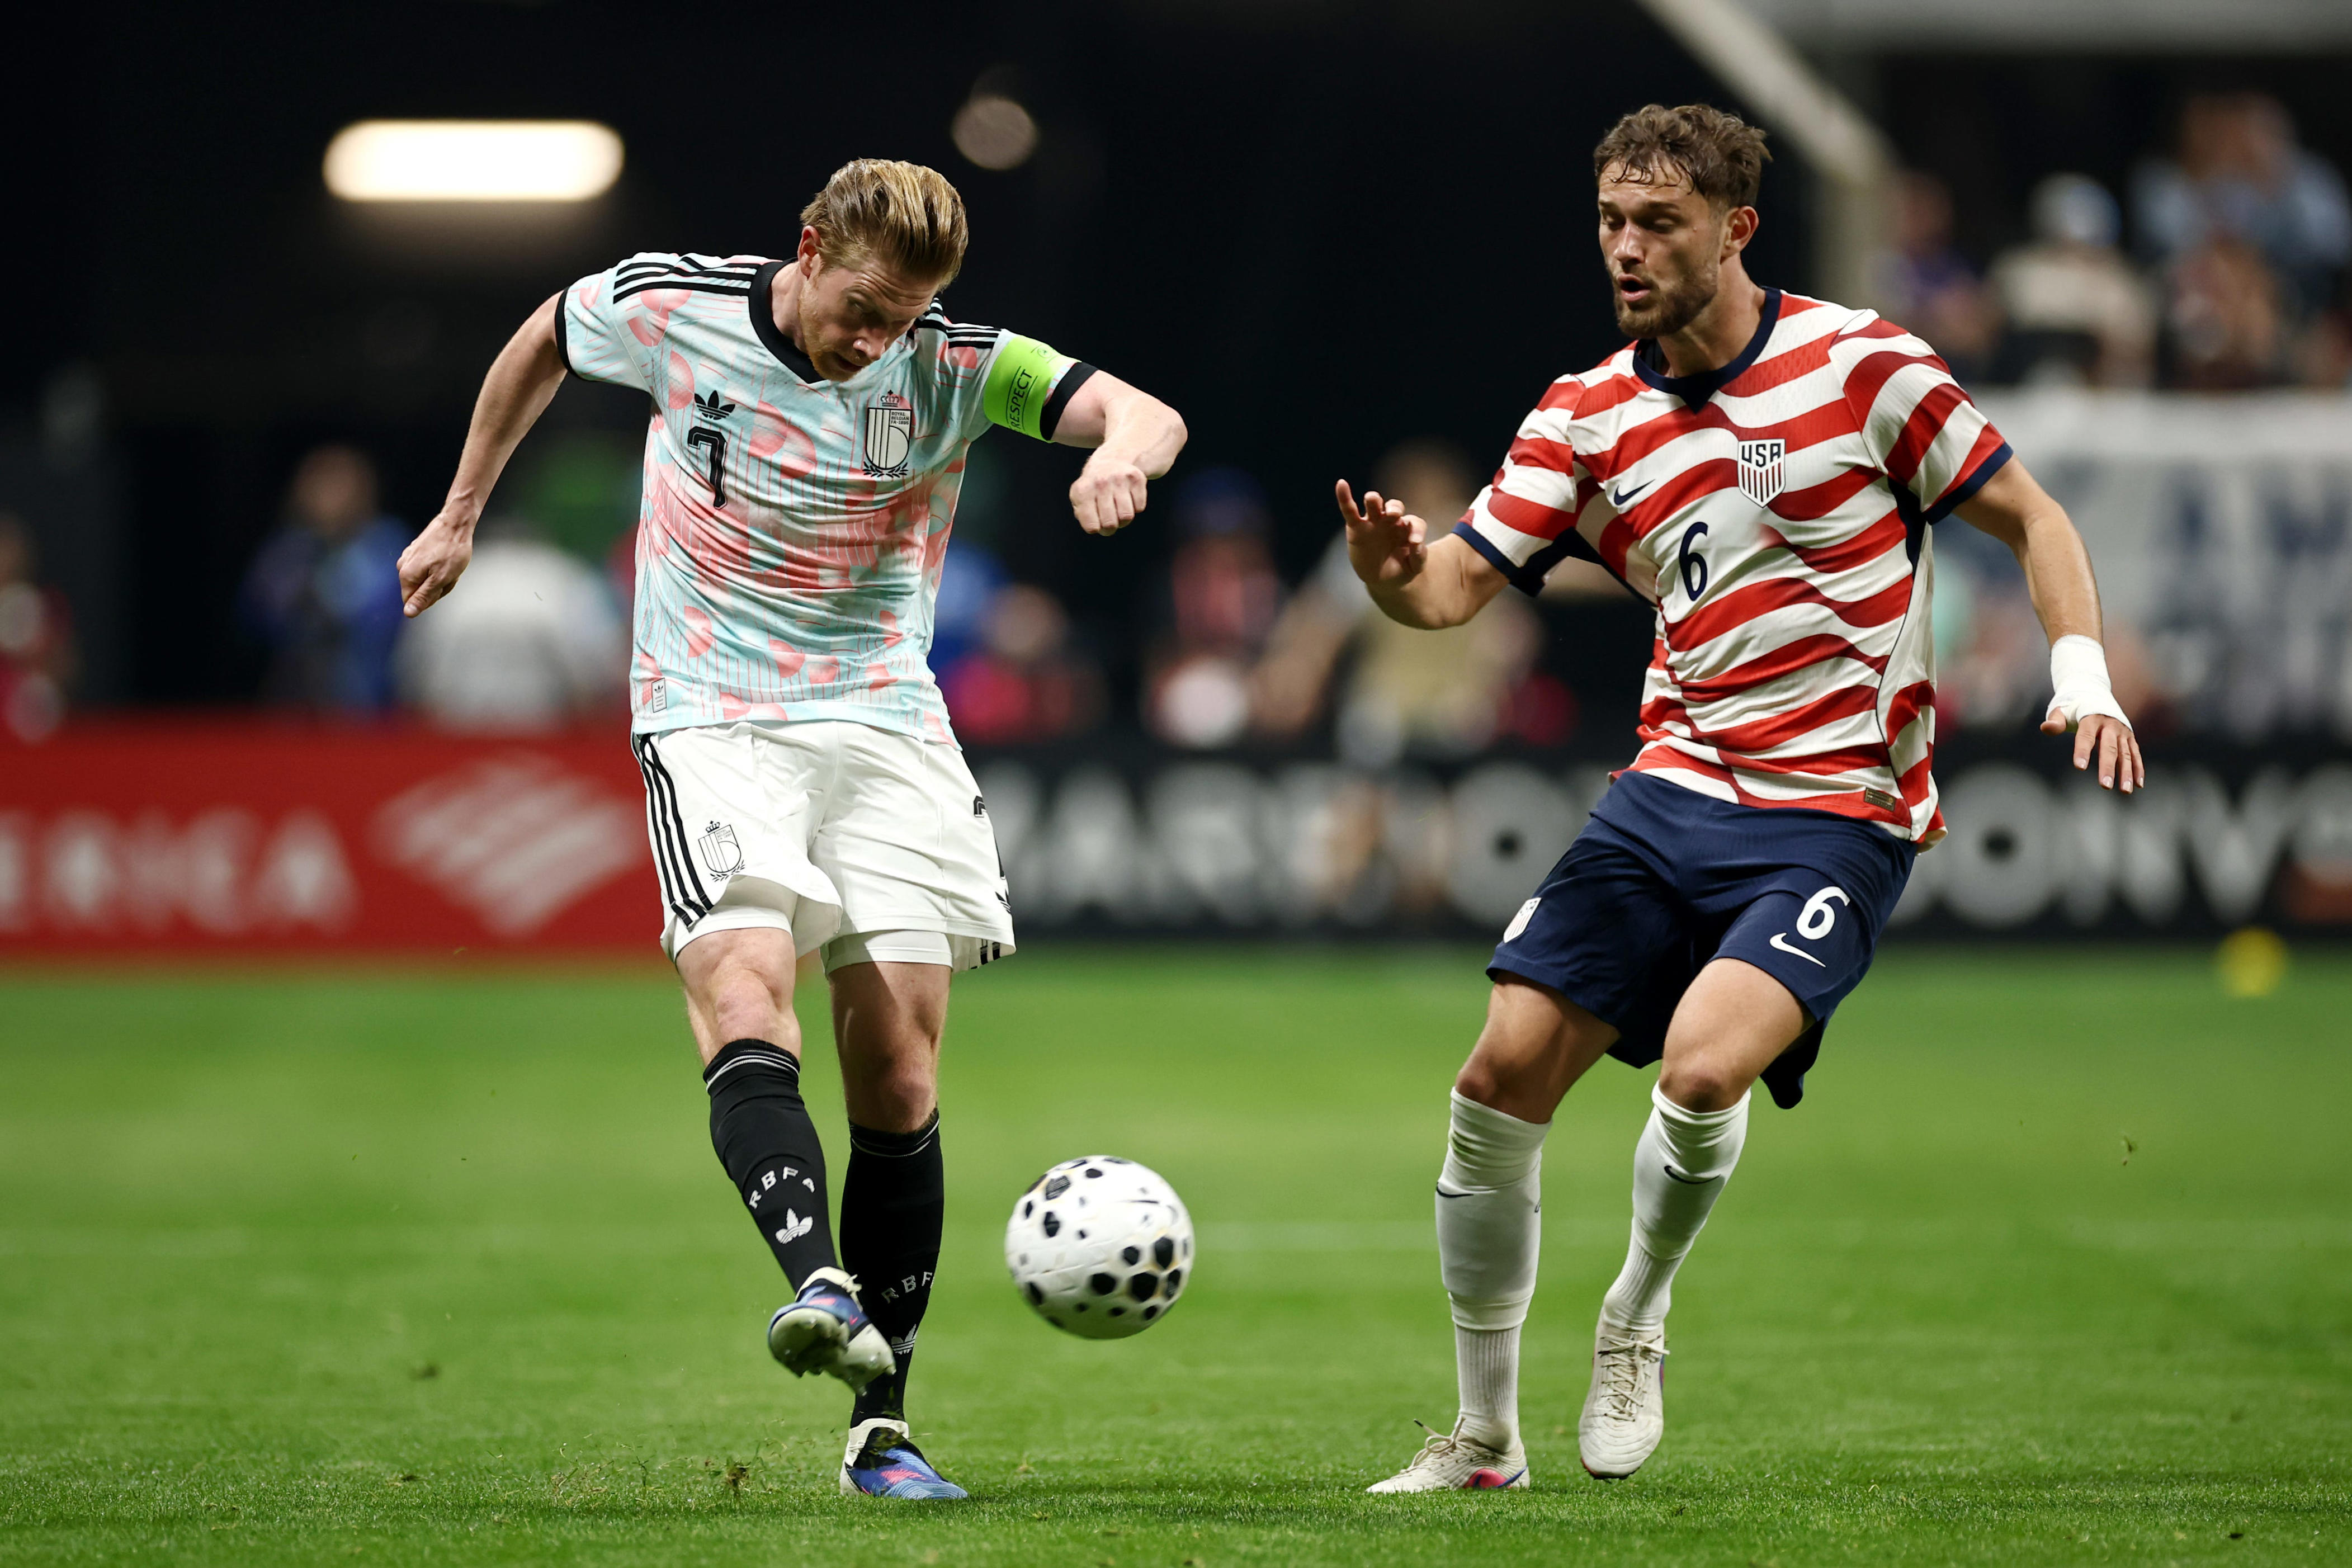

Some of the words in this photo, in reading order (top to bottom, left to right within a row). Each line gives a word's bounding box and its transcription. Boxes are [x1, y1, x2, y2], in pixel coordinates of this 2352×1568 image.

[1009, 369, 1032, 429] RESPECT
[687, 426, 728, 511] 7
[1741, 443, 1781, 468] USA
[1679, 521, 1708, 601] 6
[1796, 886, 1851, 940] 6
